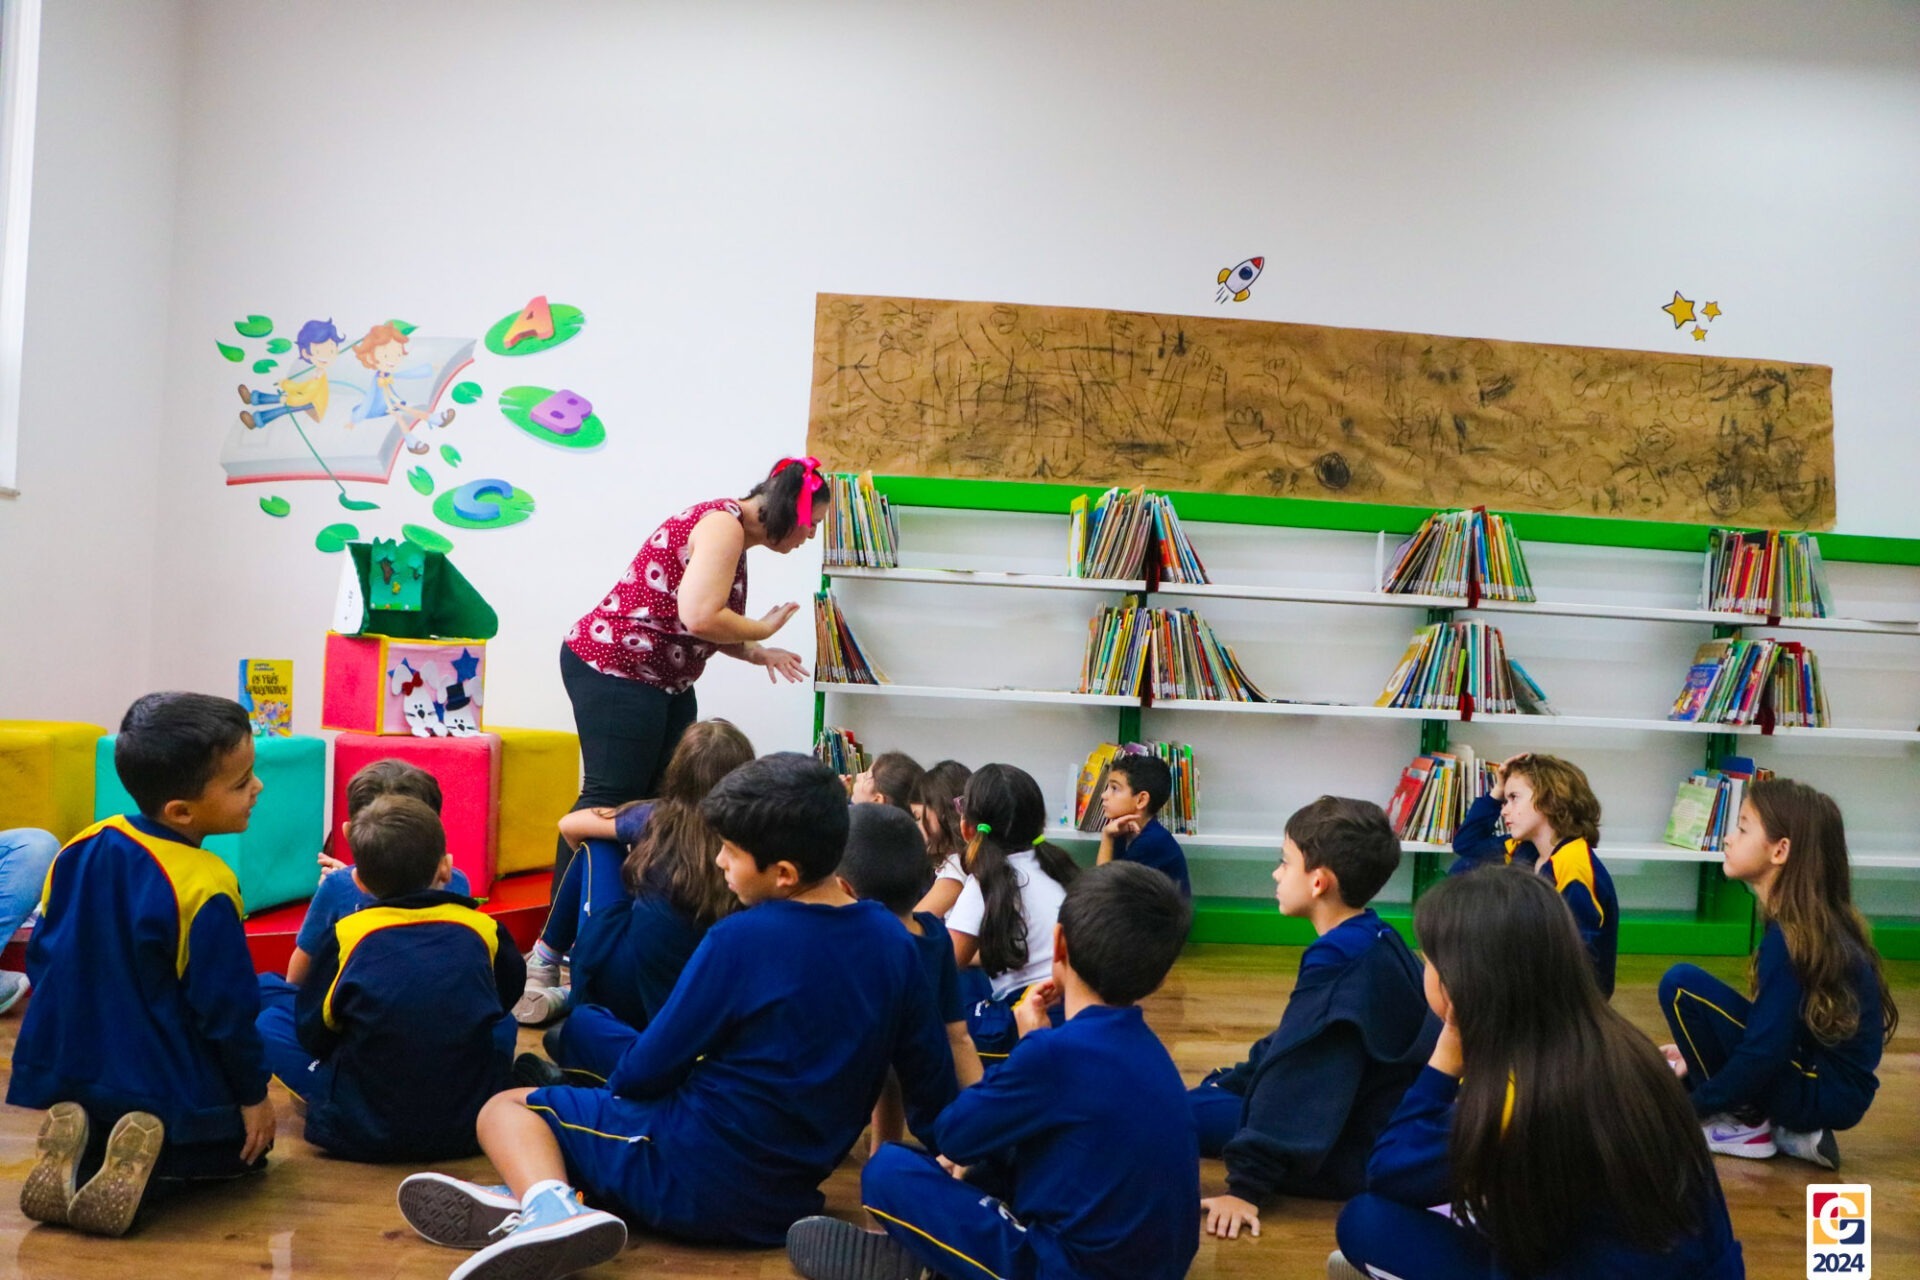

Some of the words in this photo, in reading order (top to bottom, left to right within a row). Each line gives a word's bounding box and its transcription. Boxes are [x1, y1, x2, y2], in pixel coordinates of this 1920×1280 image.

[503, 295, 555, 350] A
[529, 388, 593, 436] B
[453, 478, 514, 521] C
